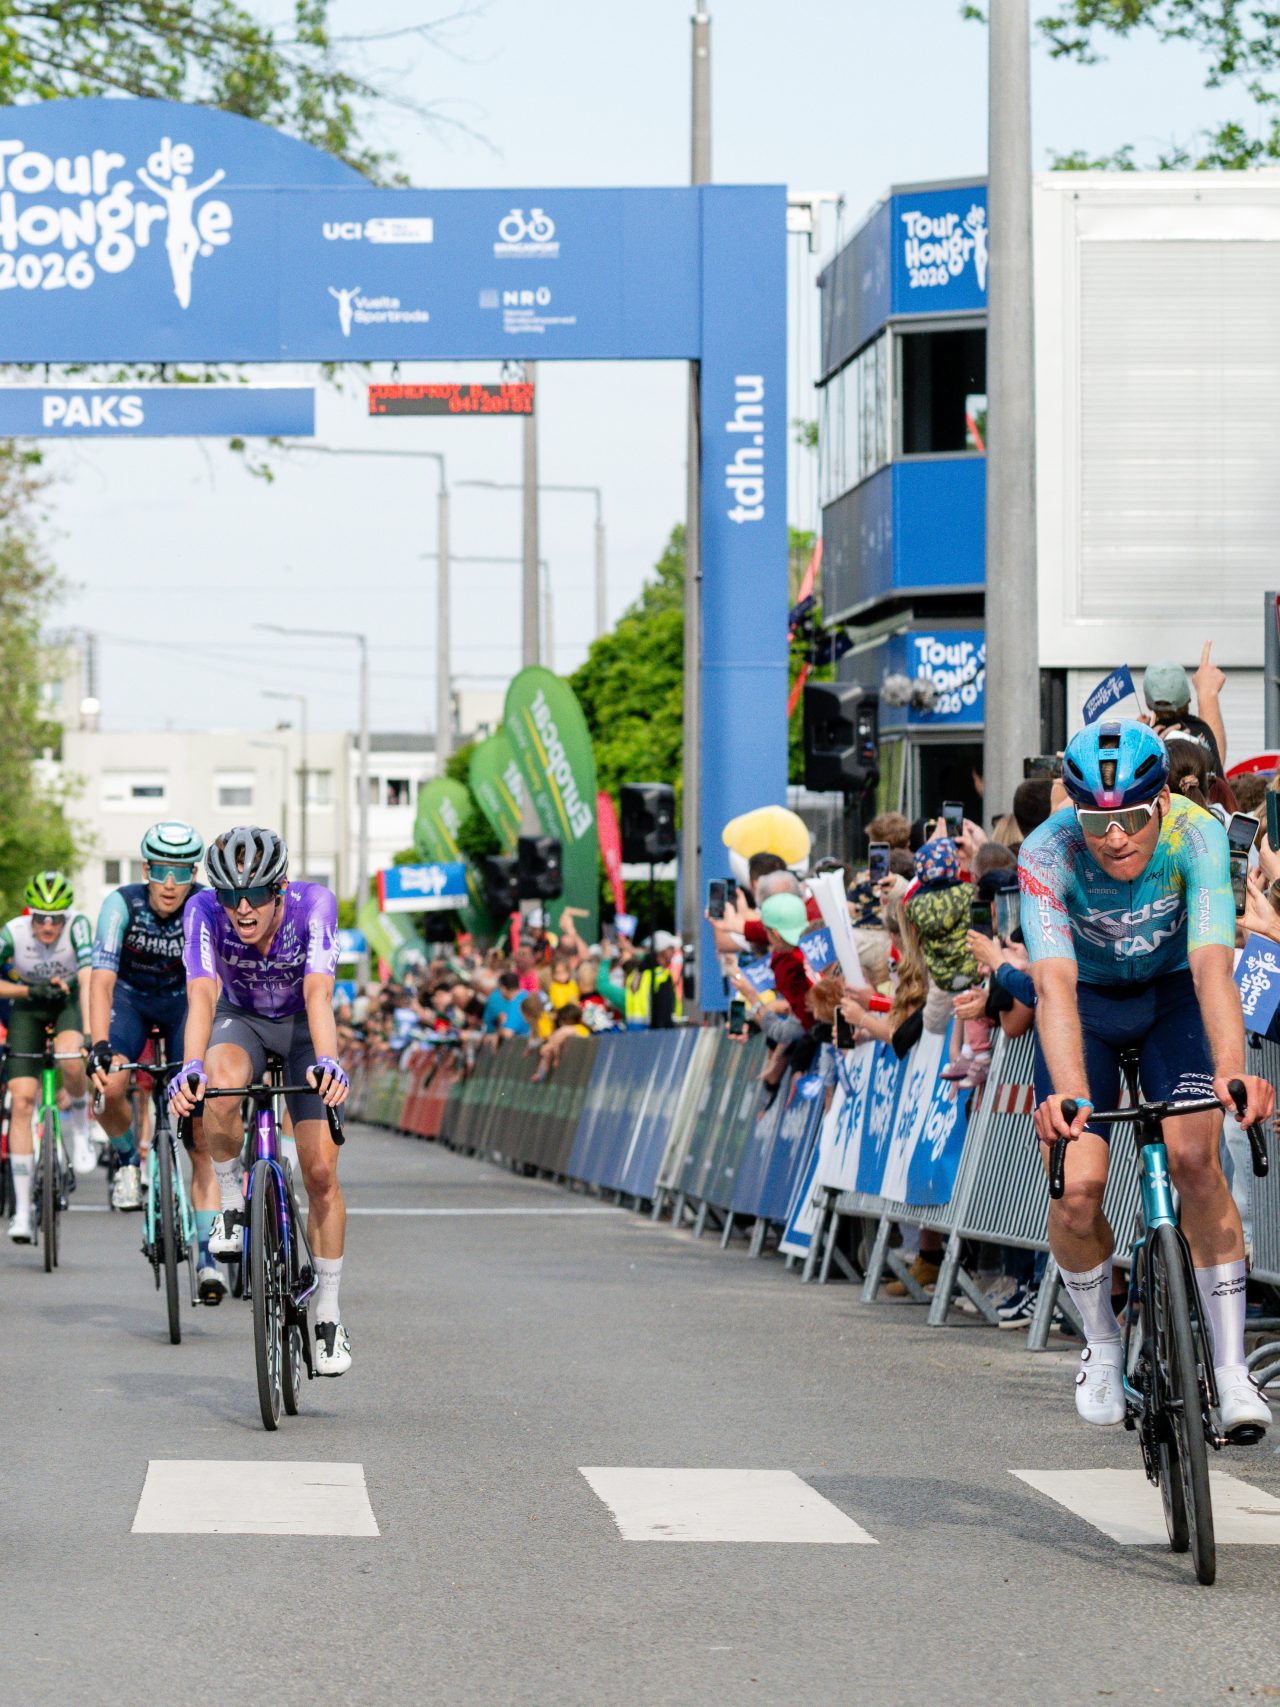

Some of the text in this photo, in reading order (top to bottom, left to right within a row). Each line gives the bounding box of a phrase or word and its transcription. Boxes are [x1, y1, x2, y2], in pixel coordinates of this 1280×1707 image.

[147, 132, 195, 181] de
[322, 222, 363, 240] UCI
[901, 210, 959, 239] Tour
[908, 264, 949, 289] 2026
[42, 394, 144, 428] PAKS
[725, 374, 765, 524] tdh.hu
[915, 636, 974, 666] Tour
[1198, 887, 1211, 936] ASTANA
[222, 953, 307, 972] Jayco
